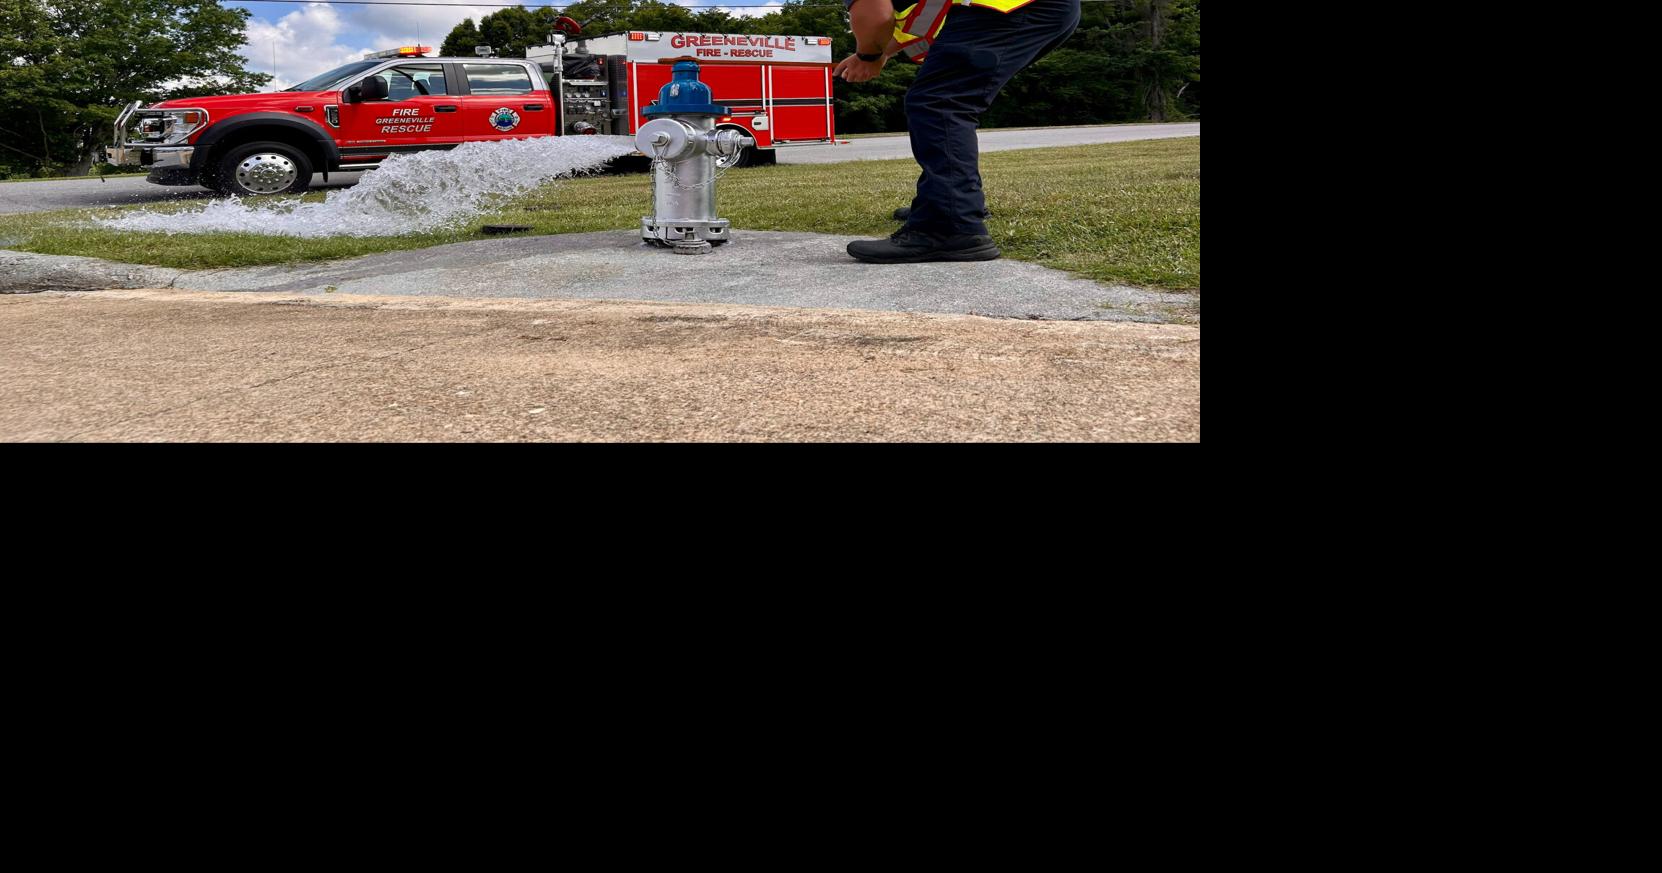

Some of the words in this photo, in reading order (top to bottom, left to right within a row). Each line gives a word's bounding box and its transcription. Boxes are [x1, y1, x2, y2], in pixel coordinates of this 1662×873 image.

[671, 35, 796, 51] GREENEVILLE
[696, 49, 721, 57] FIRE
[730, 49, 773, 57] RESCUE
[392, 108, 420, 116] FIRE
[381, 125, 432, 133] RESCUE
